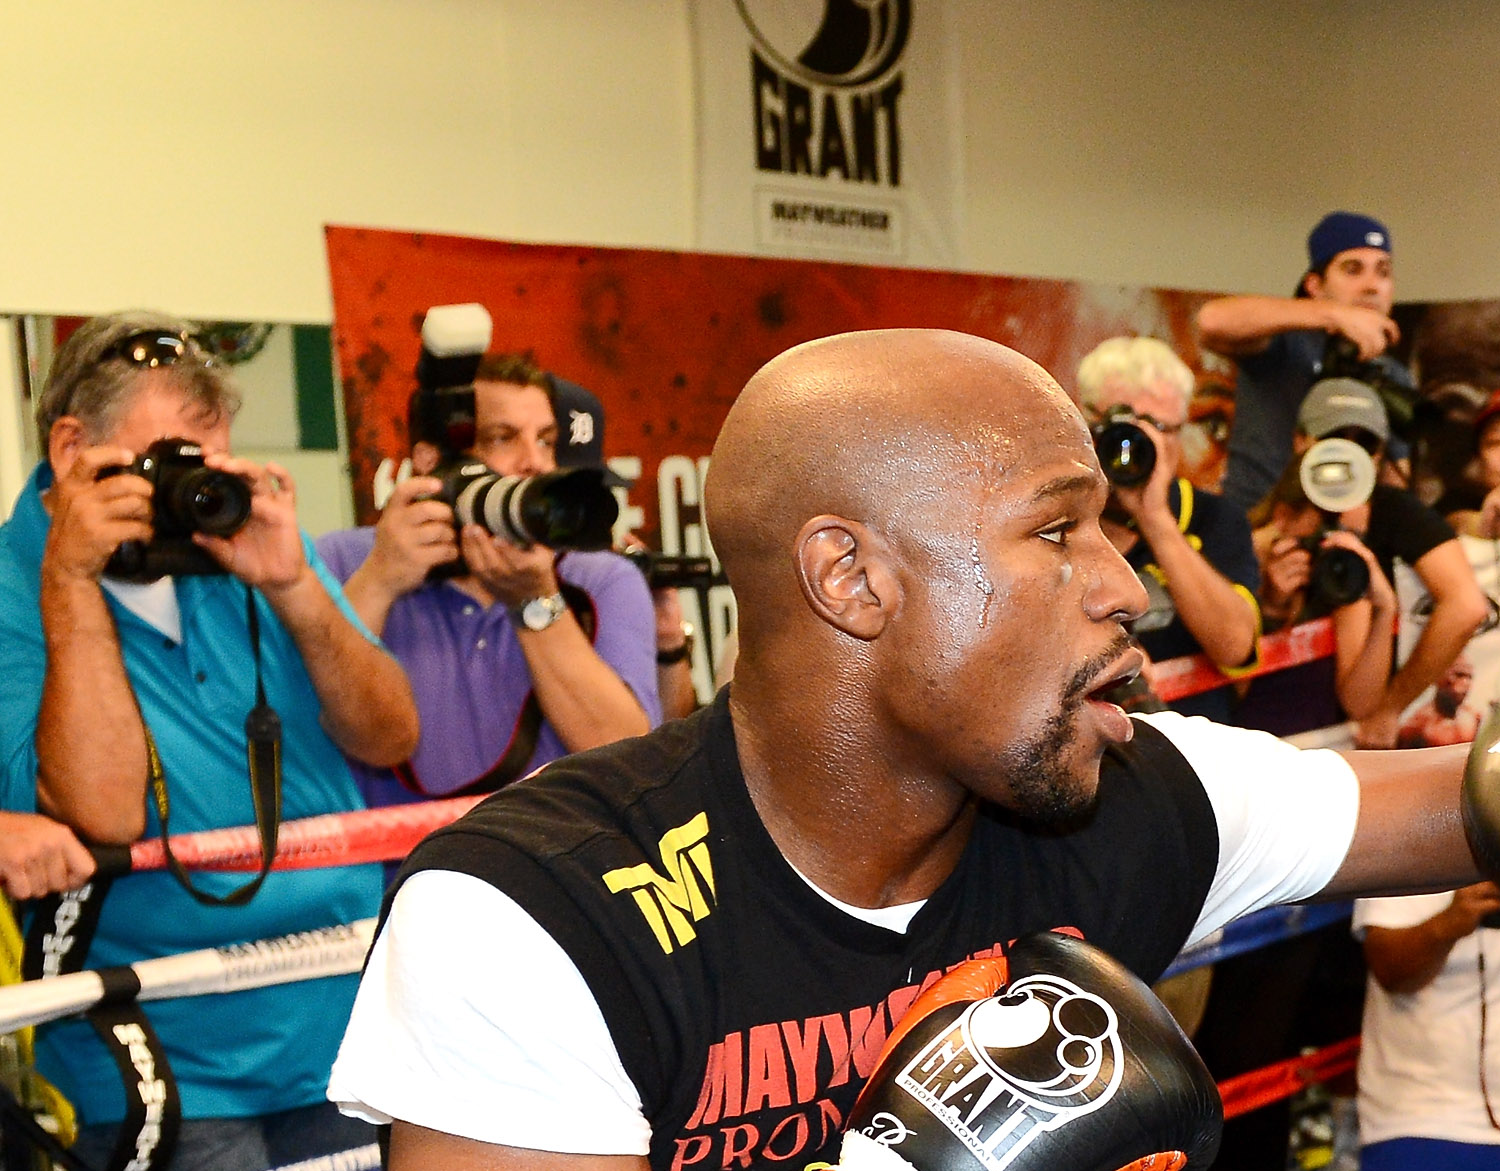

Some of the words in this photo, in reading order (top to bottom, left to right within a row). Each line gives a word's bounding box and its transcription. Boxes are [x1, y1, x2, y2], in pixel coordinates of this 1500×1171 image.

[752, 52, 903, 188] GRANT
[903, 1079, 992, 1163] PROFESSIONAL
[907, 1025, 1060, 1163] GRANT
